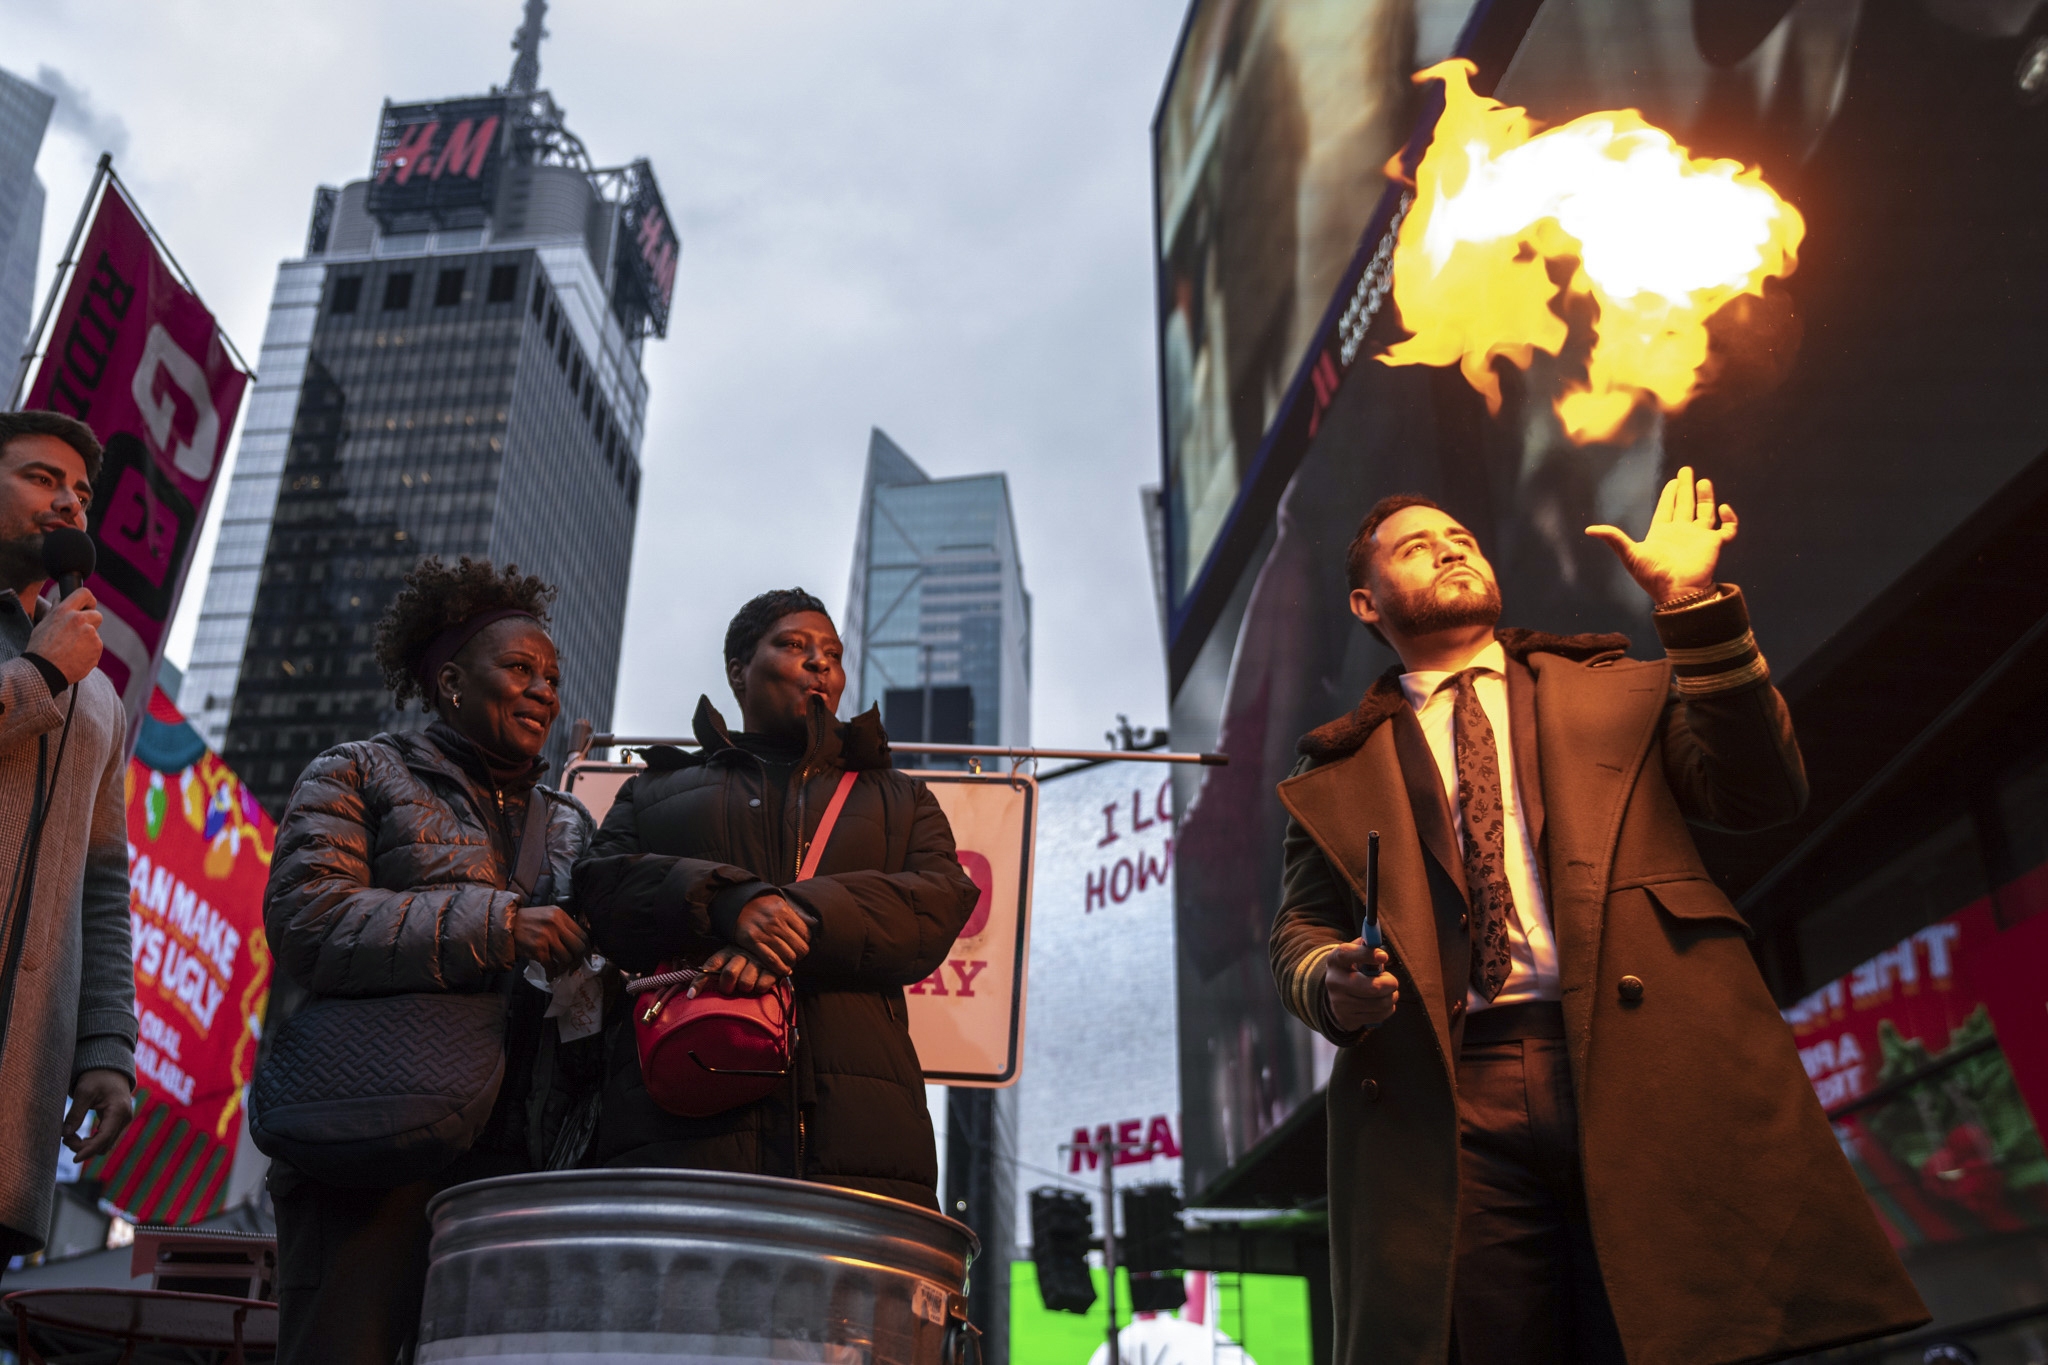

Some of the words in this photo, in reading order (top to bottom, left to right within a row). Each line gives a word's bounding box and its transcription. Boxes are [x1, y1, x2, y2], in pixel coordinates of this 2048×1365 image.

[376, 115, 499, 185] H&M
[127, 842, 175, 916] AN
[168, 880, 241, 982] MAKE
[1085, 834, 1175, 915] HOW
[161, 940, 225, 1030] UGLY
[908, 959, 987, 998] AY
[1068, 1112, 1182, 1175] MEA
